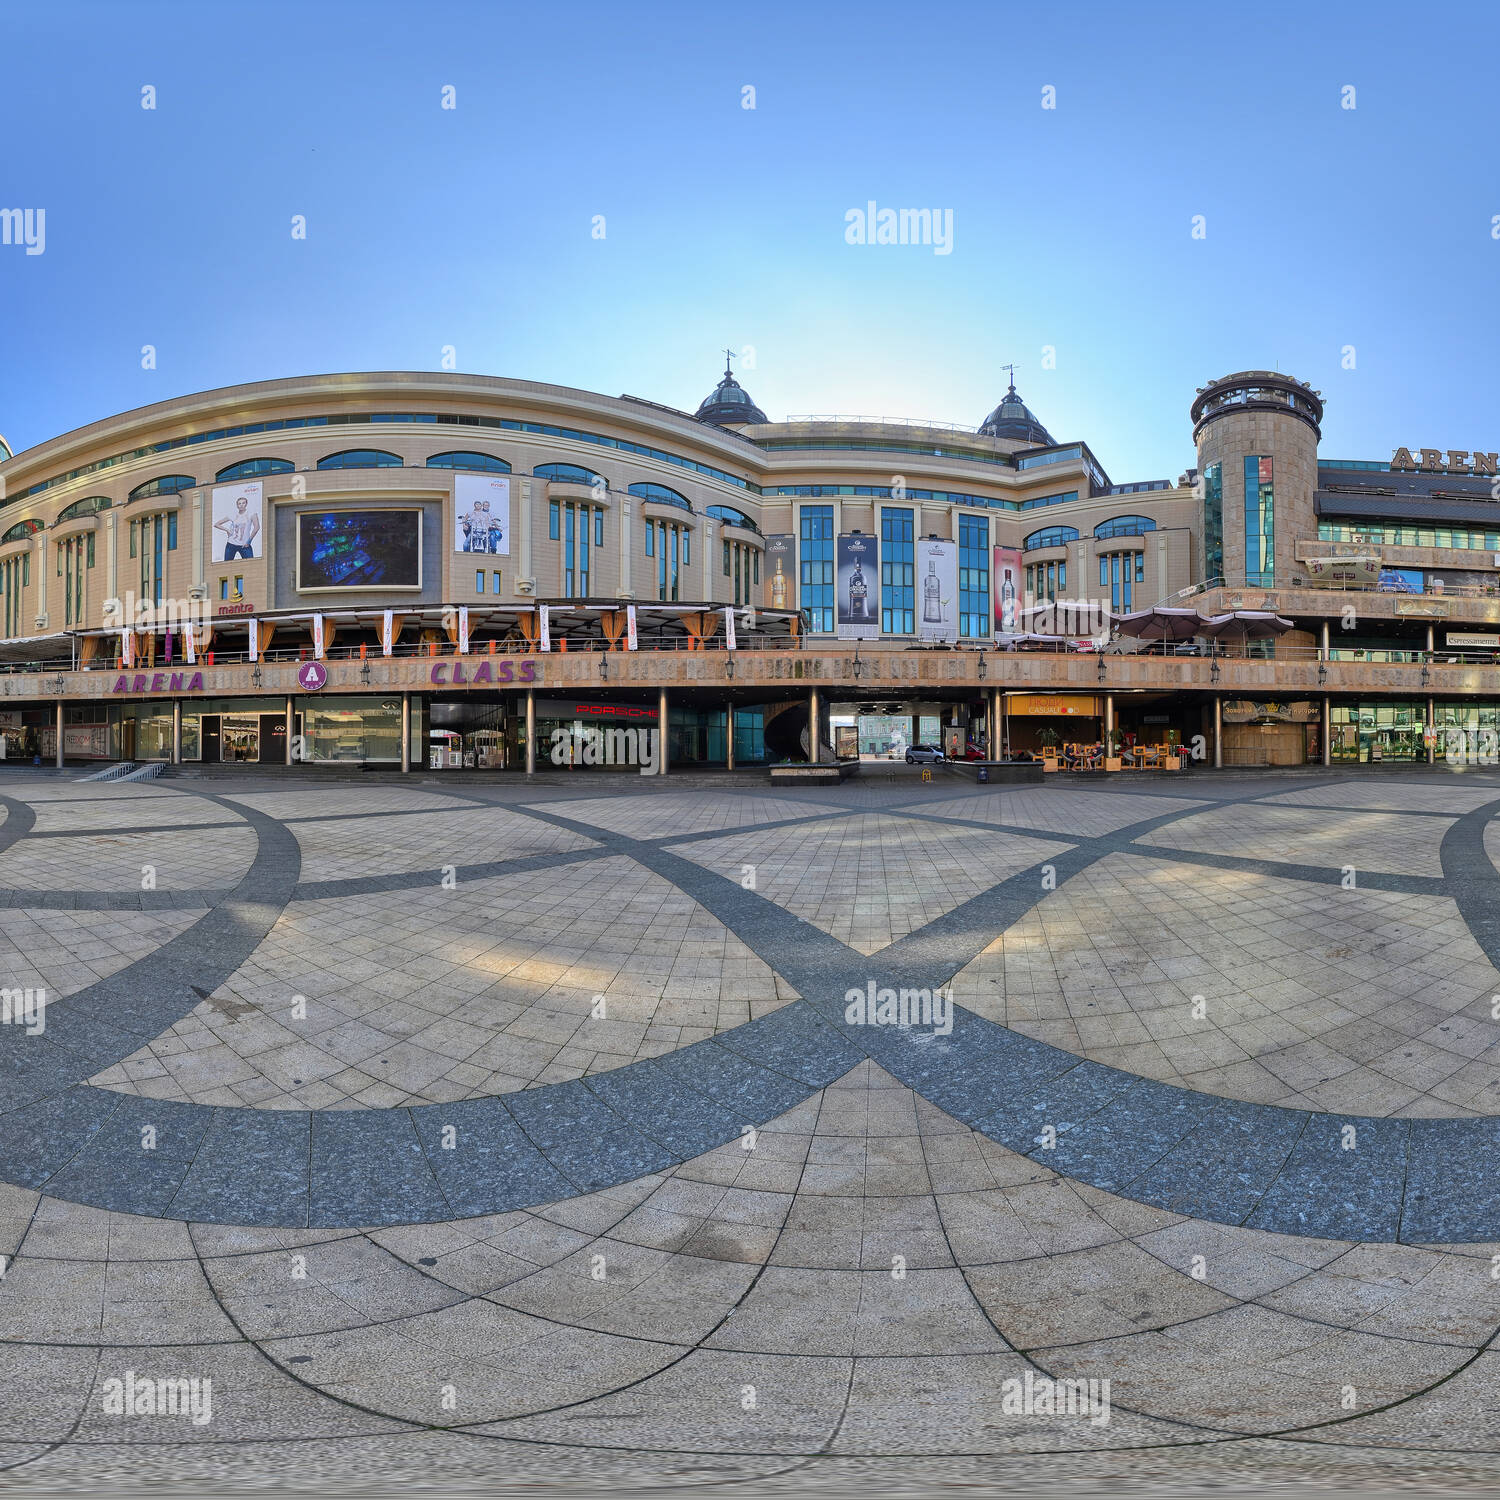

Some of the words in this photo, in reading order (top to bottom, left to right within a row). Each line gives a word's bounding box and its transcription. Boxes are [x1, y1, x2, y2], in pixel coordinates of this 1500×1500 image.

[218, 603, 254, 615] mantra
[431, 660, 536, 684] CLASS
[113, 672, 203, 693] ARENA
[576, 705, 659, 718] PORSCHE
